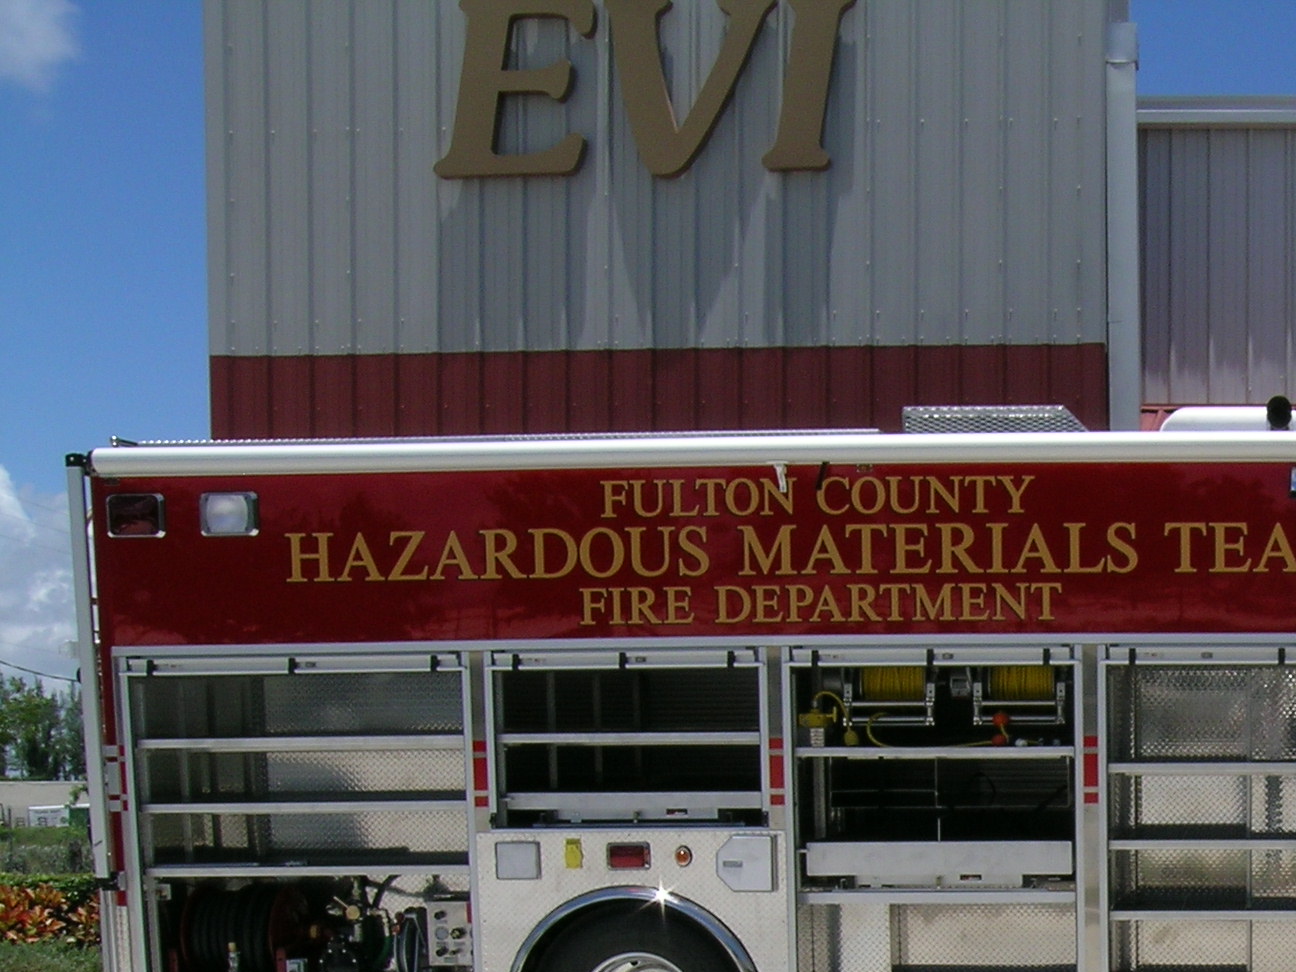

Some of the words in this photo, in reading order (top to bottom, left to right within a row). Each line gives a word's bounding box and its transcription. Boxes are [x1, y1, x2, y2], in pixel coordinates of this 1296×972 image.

[434, 0, 856, 179] EVI
[600, 477, 798, 518] FULTON
[816, 475, 1035, 514] COUNTY
[285, 525, 710, 582] HAZARDOUS
[738, 522, 1139, 577] MATERIALS
[580, 587, 694, 625] FIRE
[714, 582, 1061, 624] DEPARTMENT
